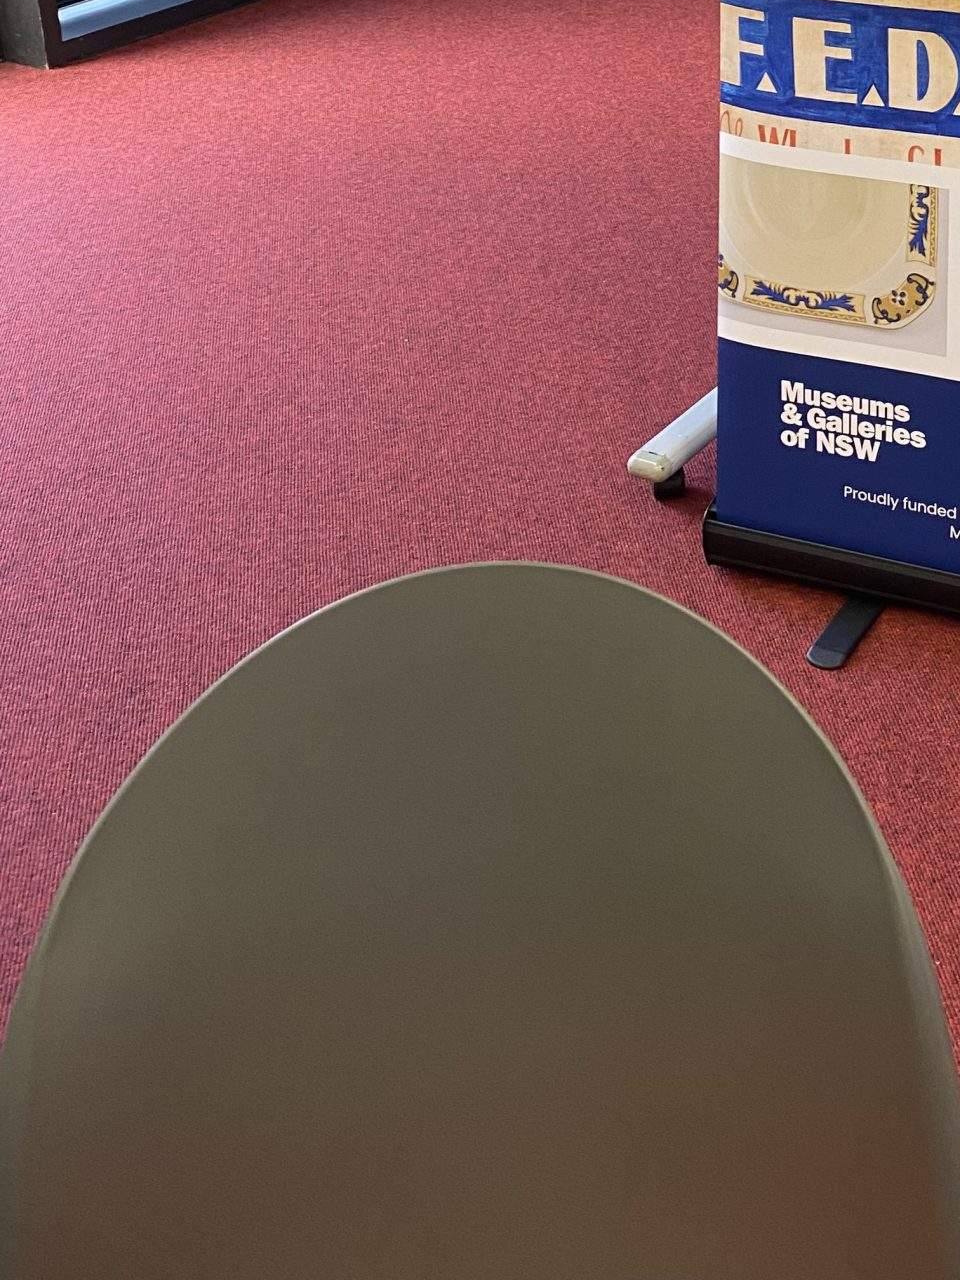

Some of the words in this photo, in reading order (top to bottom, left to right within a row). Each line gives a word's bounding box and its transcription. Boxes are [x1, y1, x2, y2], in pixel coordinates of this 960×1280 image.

[780, 379, 911, 422] Museums
[780, 402, 803, 426] &
[806, 407, 927, 448] Galleries
[780, 428, 809, 449] of
[816, 430, 881, 462] NSW
[843, 486, 899, 510] Proudly
[903, 497, 957, 519] funded
